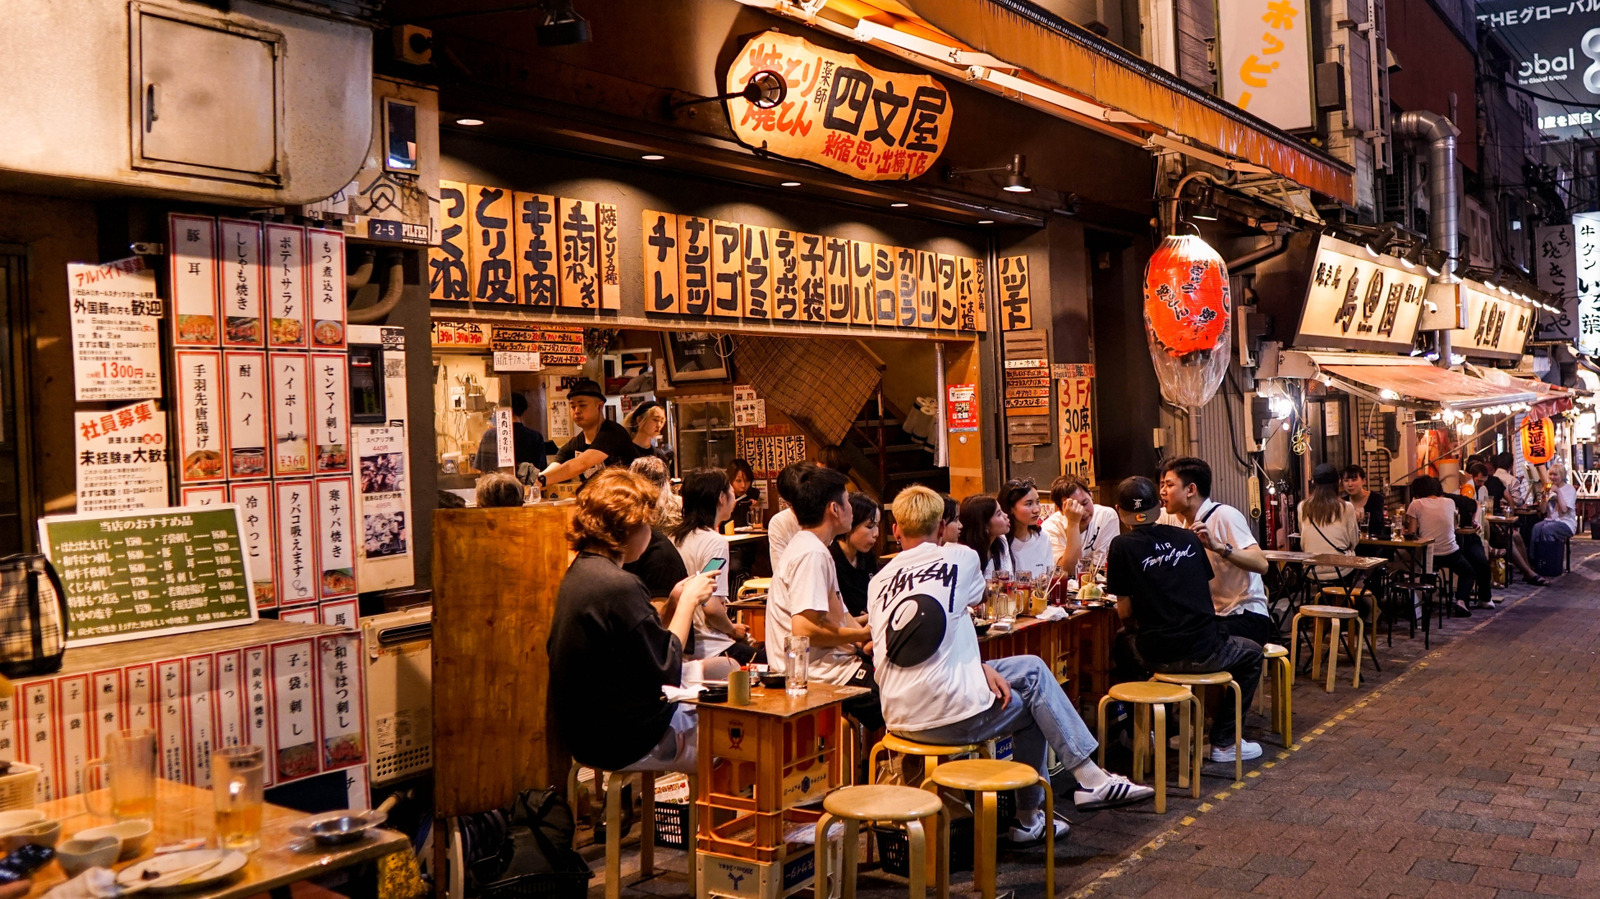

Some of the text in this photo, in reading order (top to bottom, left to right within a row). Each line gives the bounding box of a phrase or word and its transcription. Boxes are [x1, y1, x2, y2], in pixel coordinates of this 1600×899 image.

[823, 66, 946, 153] 四文屋
[375, 223, 395, 236] 2-5
[475, 187, 515, 302] とり皮
[715, 225, 742, 311] アゴ
[74, 299, 162, 316] 外国籍の方も歓迎
[280, 237, 293, 317] ポテトサラダ
[322, 242, 333, 304] もつ煮込み
[745, 228, 769, 318] ハラミ
[801, 236, 825, 321] 子袋
[80, 403, 152, 440] 社員募集
[193, 364, 209, 449] 手羽先唐揚げ
[239, 364, 253, 426] 酎ハイ
[284, 365, 297, 441] ハイボール
[324, 365, 337, 443] センマイ刺し
[100, 516, 194, 532] 当店のおすすめ品
[246, 495, 259, 557] 冷やっこ
[290, 492, 304, 577] タバコ吸えます
[329, 489, 342, 558] 寒サバ焼き
[1155, 542, 1172, 551] AIR
[288, 653, 303, 736] 子袋刺し
[334, 647, 350, 729] 和牛はつ刺し
